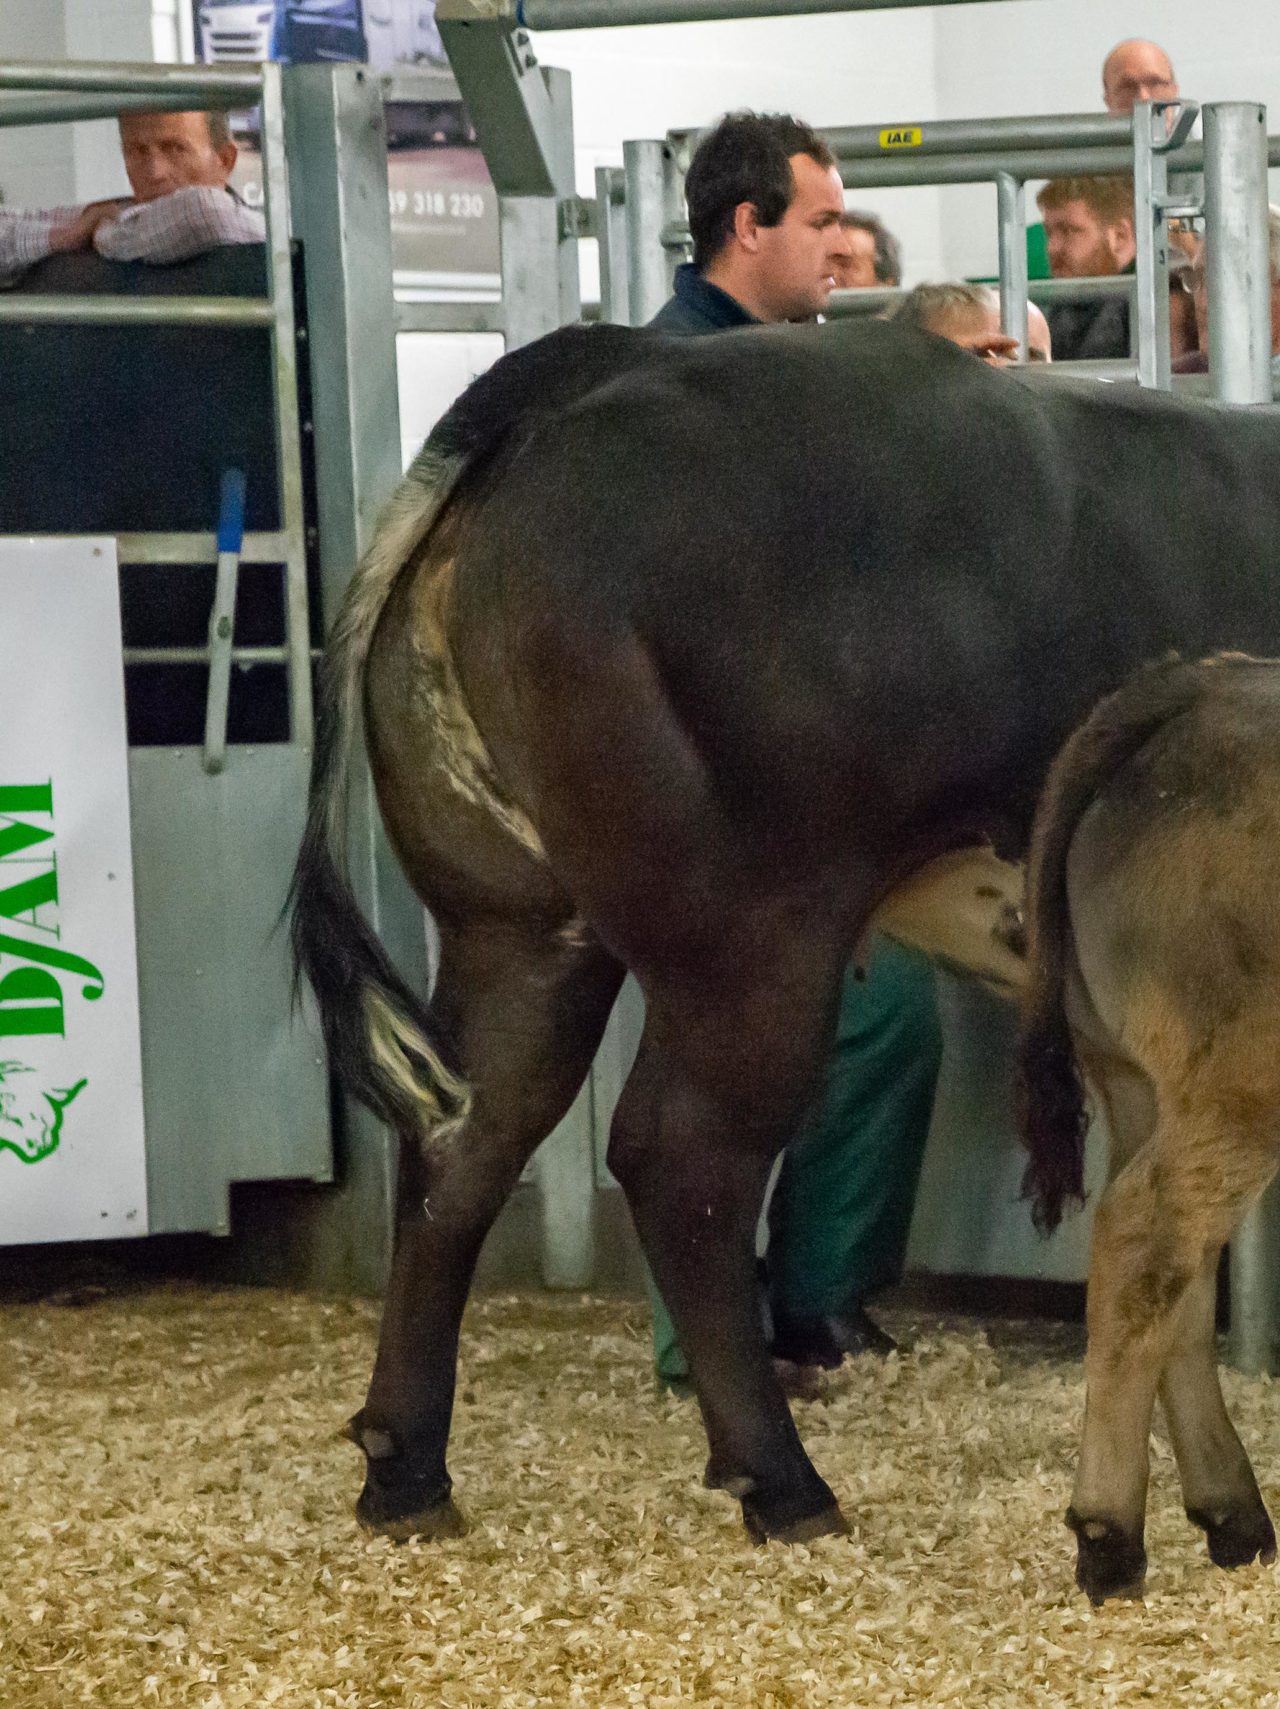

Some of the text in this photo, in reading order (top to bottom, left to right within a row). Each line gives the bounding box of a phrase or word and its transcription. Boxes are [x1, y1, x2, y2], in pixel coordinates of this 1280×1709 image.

[887, 131, 913, 145] IAE
[413, 190, 445, 215] 318
[449, 191, 484, 218] 230
